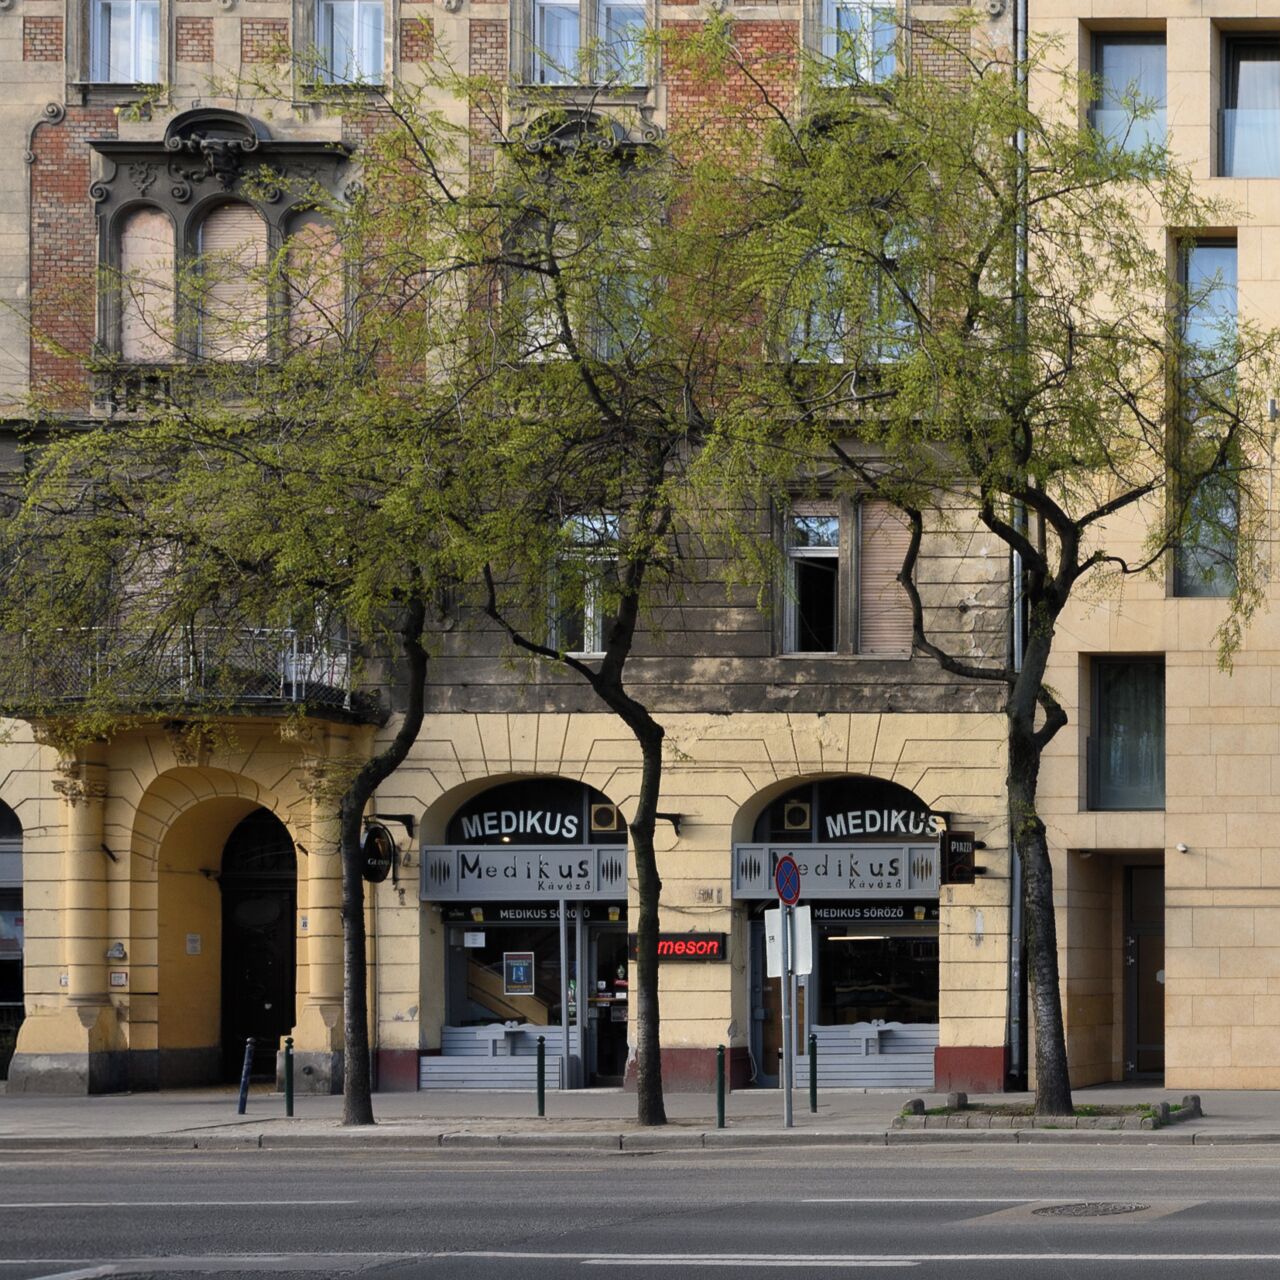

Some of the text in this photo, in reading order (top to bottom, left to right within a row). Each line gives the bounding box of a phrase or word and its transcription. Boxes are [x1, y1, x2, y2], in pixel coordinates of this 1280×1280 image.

[461, 810, 578, 839] MEDIKUS
[826, 809, 946, 838] MEDIKUS
[460, 853, 589, 880] Medikus
[500, 909, 547, 919] MEDIKUS
[814, 907, 861, 918] MEDIKUS
[636, 939, 720, 956] meson
